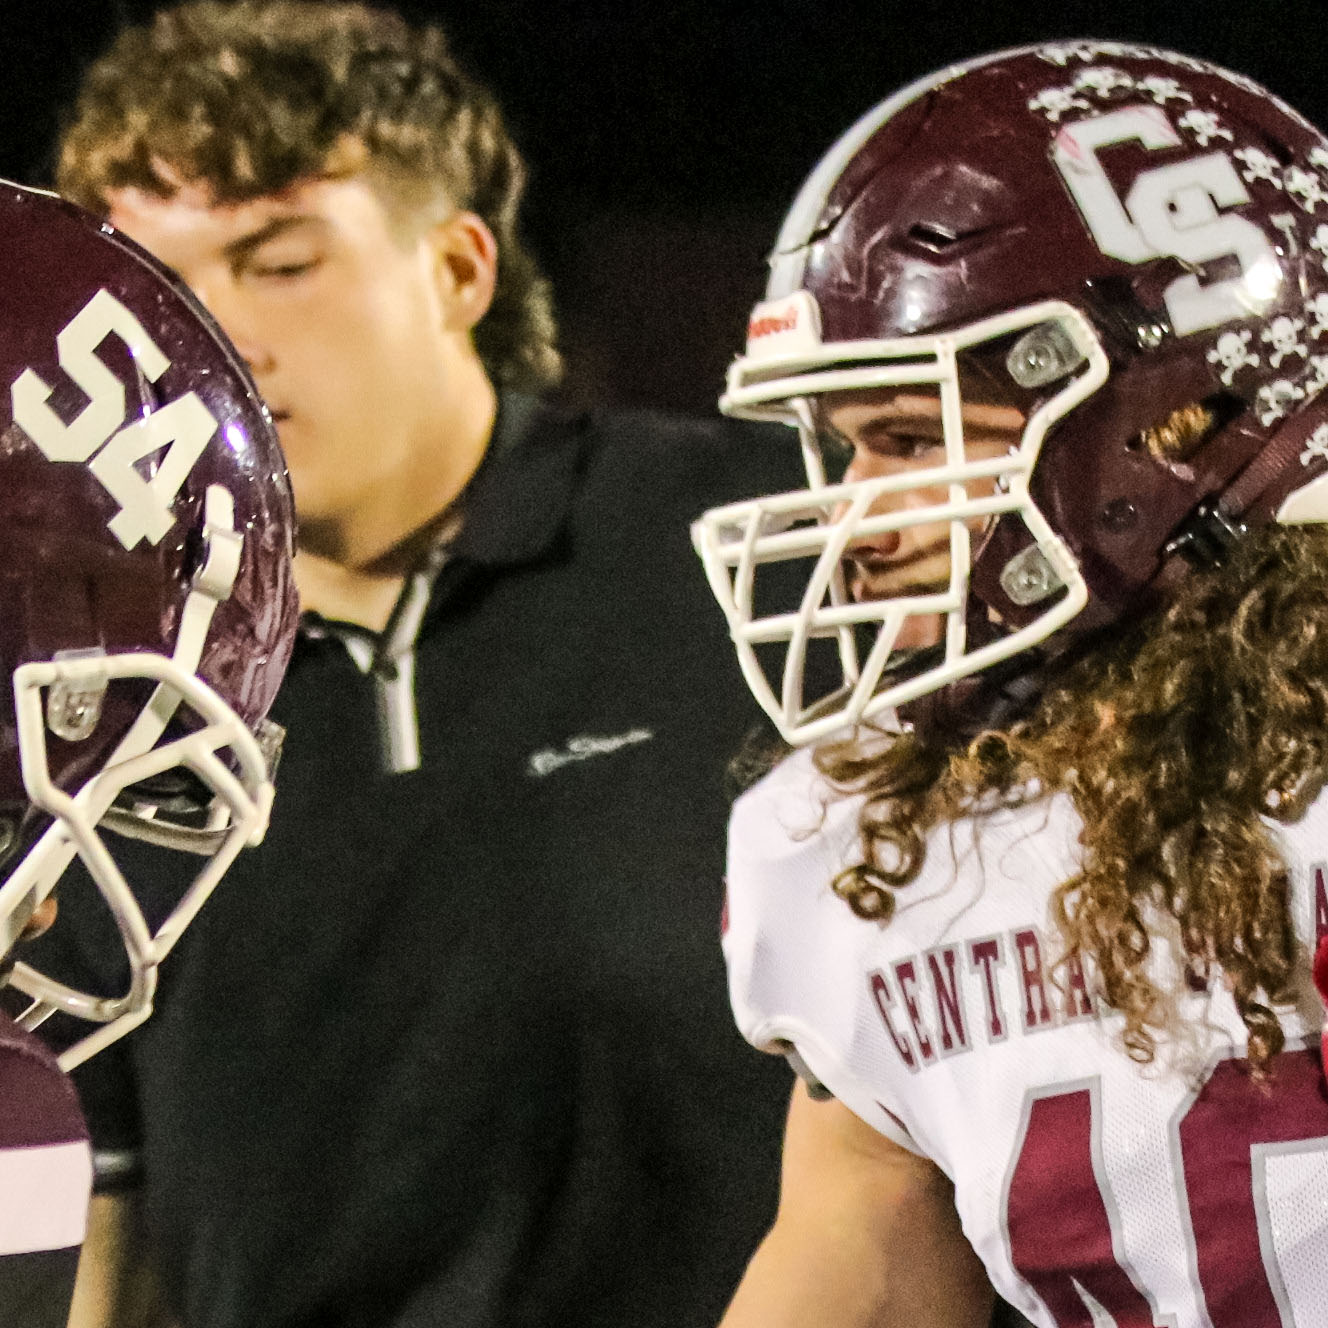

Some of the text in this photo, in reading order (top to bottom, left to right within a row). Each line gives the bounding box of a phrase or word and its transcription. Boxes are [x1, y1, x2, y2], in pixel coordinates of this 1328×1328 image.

[1050, 104, 1283, 336] CS
[10, 288, 219, 551] 54
[867, 926, 1100, 1074] CENTRA
